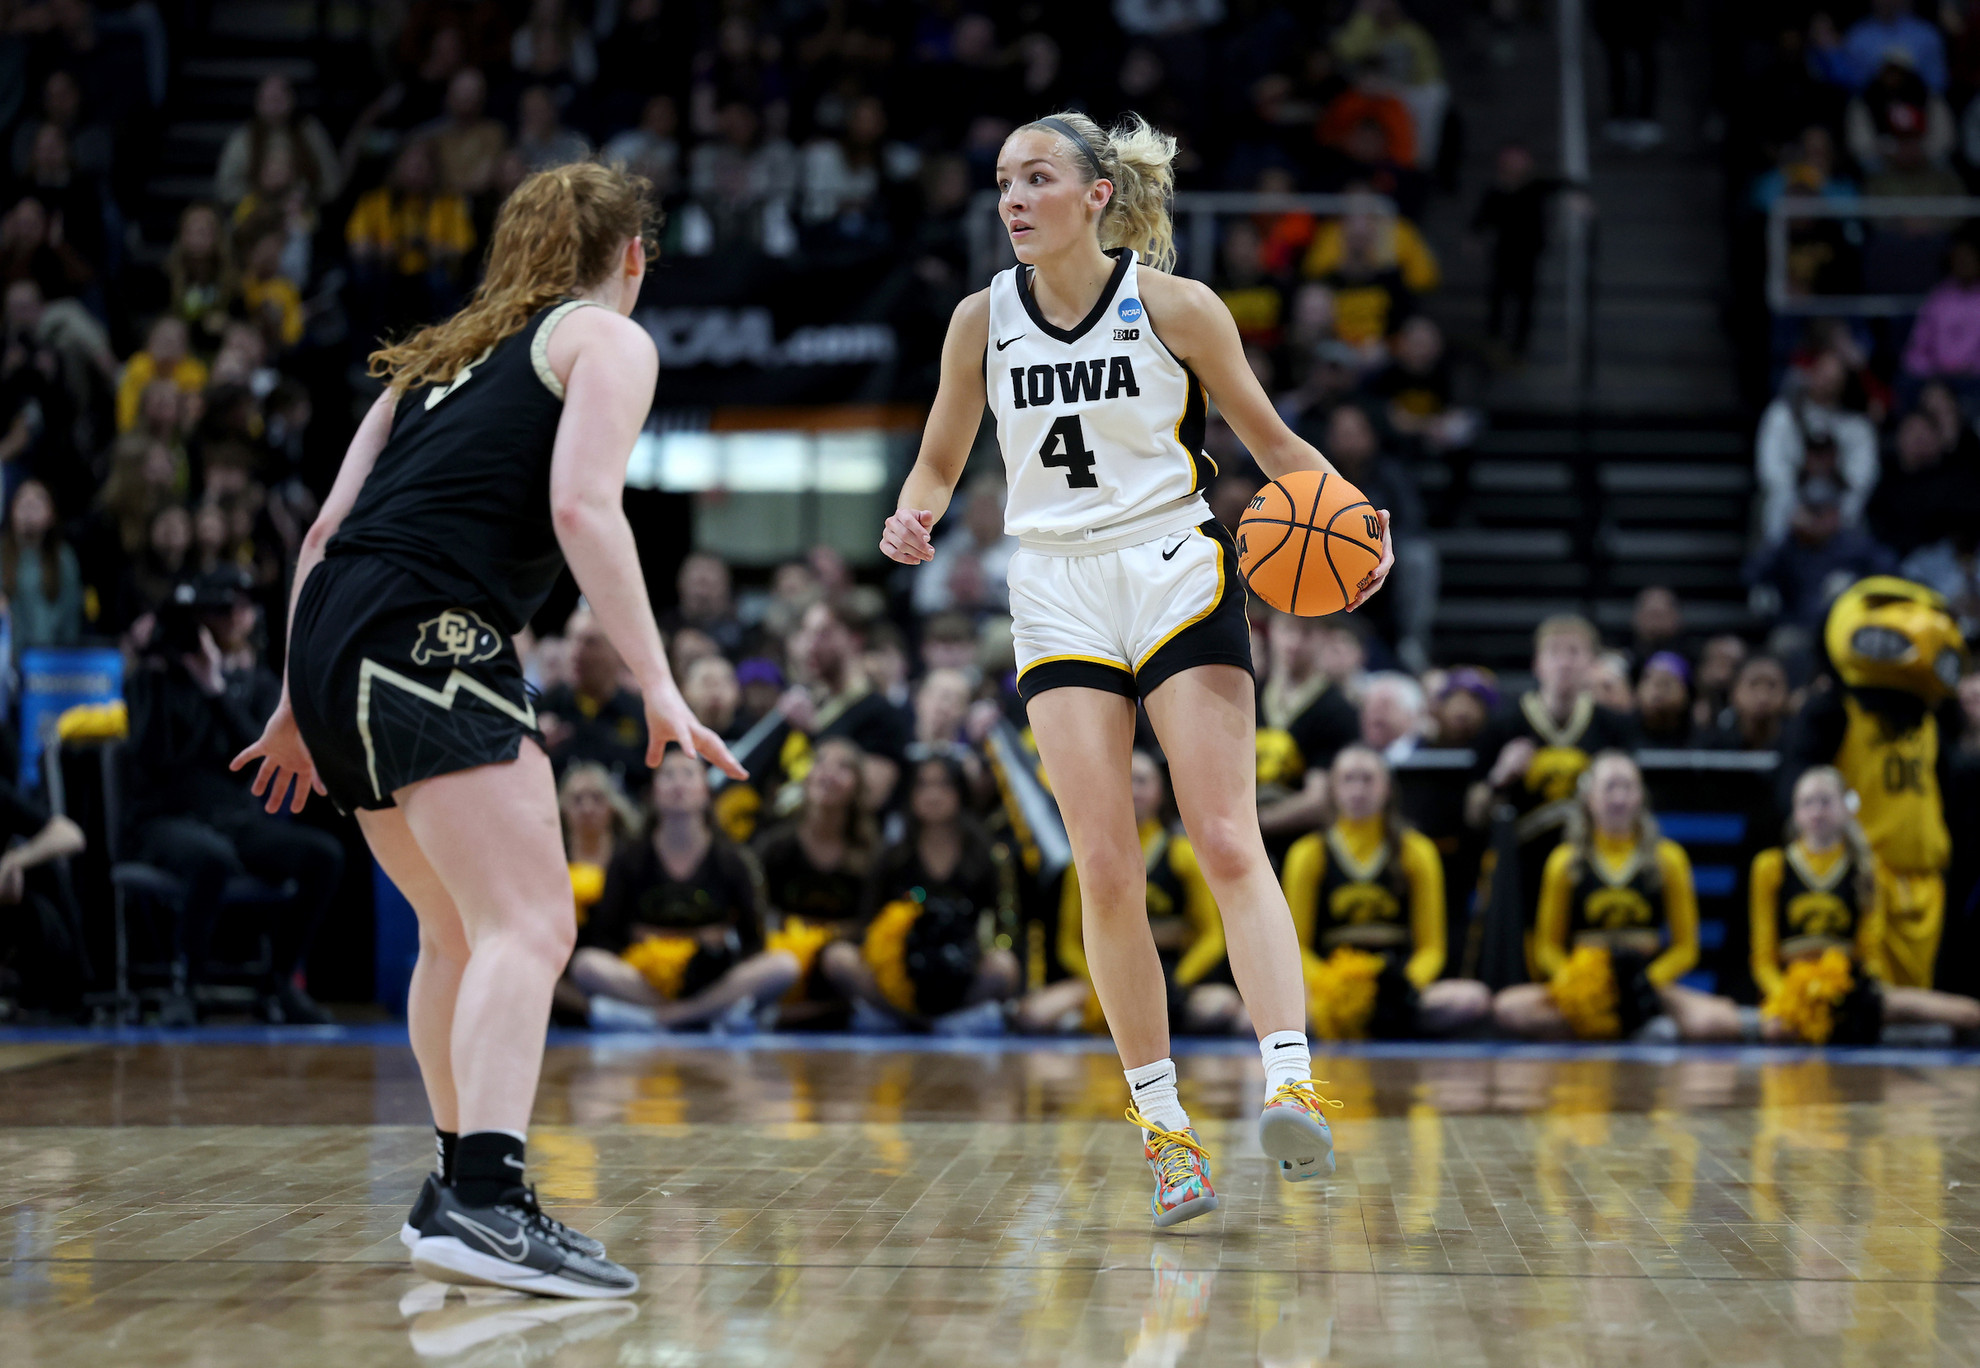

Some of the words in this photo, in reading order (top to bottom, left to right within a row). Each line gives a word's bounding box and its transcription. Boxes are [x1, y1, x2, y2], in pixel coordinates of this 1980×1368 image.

[1121, 308, 1140, 317] NCAA
[1010, 356, 1140, 409] IOWA
[1039, 414, 1098, 489] 4
